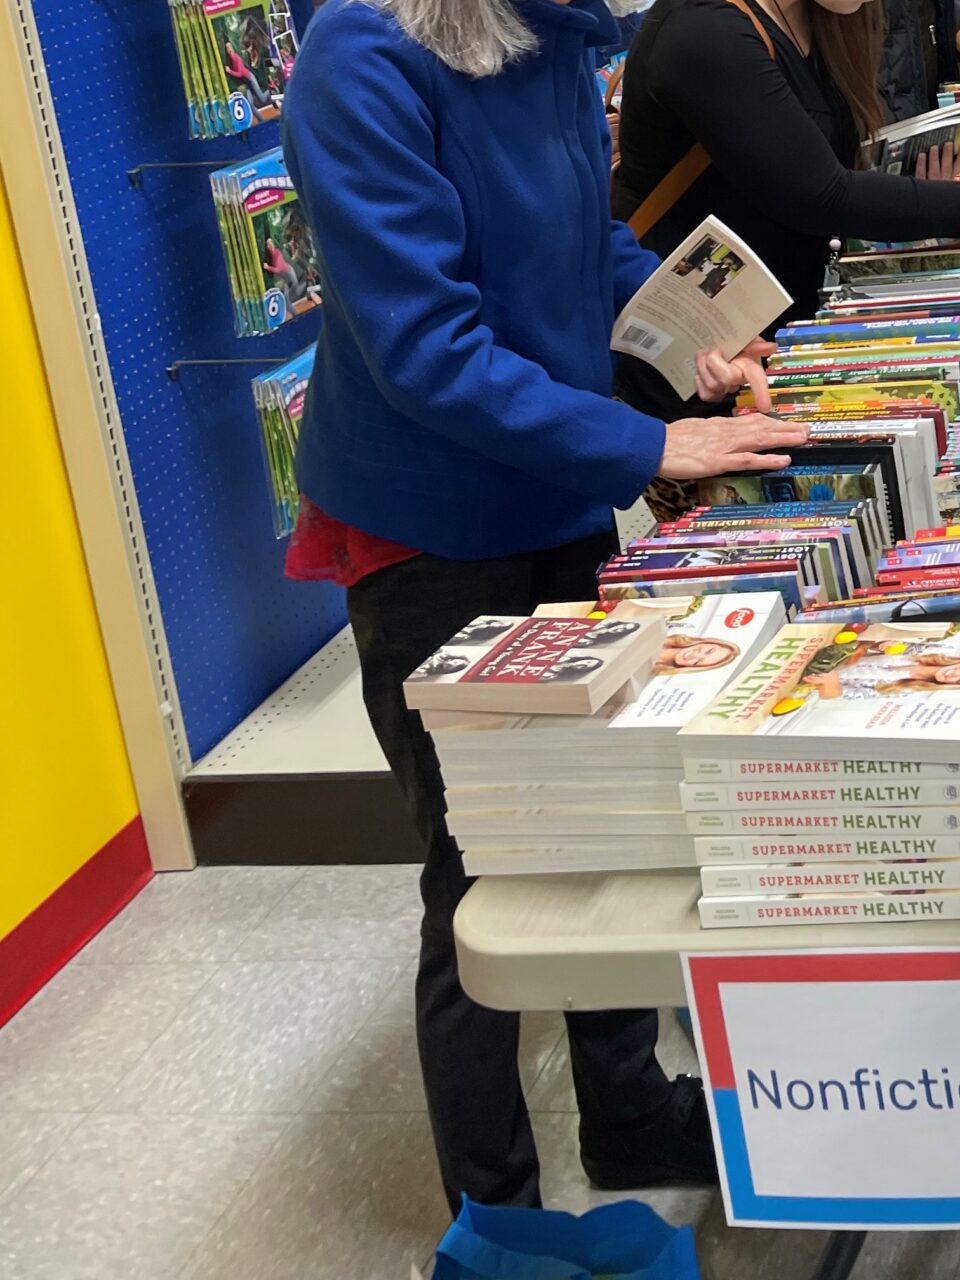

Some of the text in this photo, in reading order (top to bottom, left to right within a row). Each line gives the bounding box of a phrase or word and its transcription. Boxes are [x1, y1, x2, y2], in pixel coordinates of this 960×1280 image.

[234, 100, 245, 121] 6
[268, 297, 278, 315] 6
[774, 552, 802, 560] LOST
[782, 545, 809, 553] LOST
[496, 621, 574, 677] FRANK
[519, 621, 591, 677] ANNE
[708, 637, 806, 720] HEALTHY
[734, 634, 823, 721] SUPERMARKET
[740, 761, 839, 774] SUPERMARKET
[843, 760, 922, 775] HEALTHY
[736, 789, 836, 802] SUPERMARKET
[840, 786, 921, 802] HEALTHY
[741, 815, 839, 827] SUPERMARKET
[842, 815, 922, 829] HEALTHY
[752, 843, 852, 856] SUPERMARKET
[856, 839, 937, 855] HEALTHY
[759, 873, 860, 887] SUPERMARKET
[864, 870, 945, 886] HEALTHY
[757, 905, 858, 918] SUPERMARKET
[863, 901, 944, 917] HEALTHY
